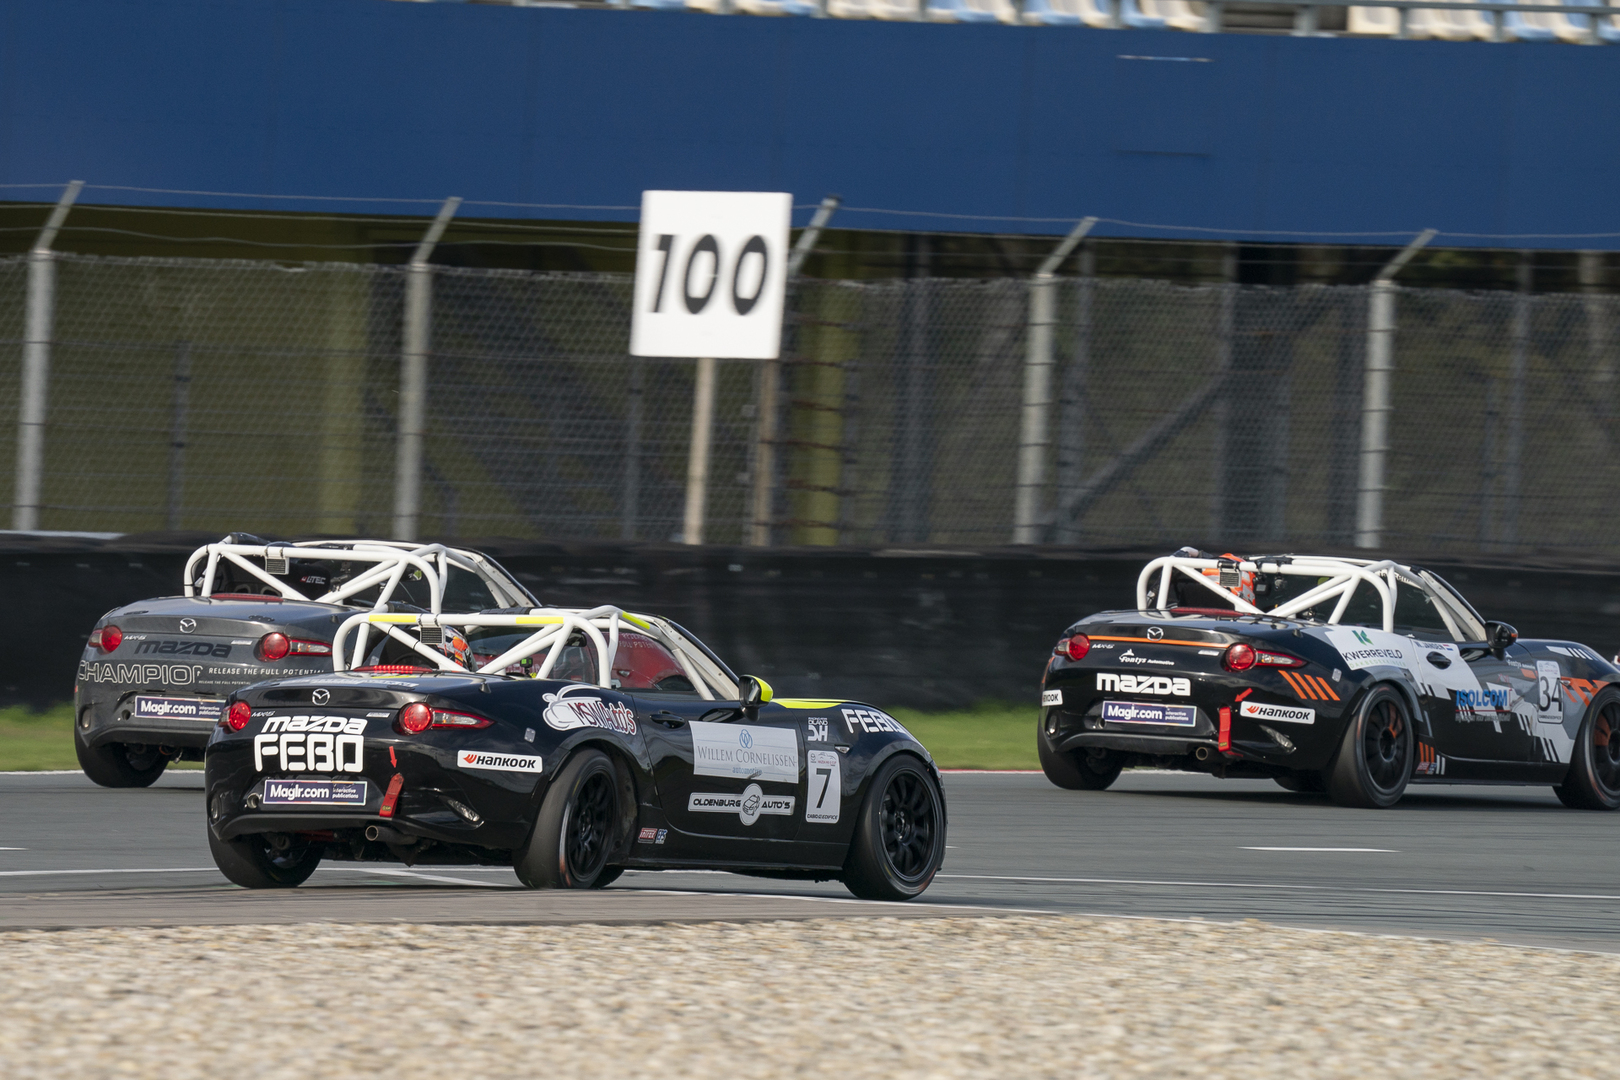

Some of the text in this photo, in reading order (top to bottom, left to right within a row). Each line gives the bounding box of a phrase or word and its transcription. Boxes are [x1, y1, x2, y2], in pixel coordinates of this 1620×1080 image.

[647, 234, 770, 316] 100
[1341, 649, 1403, 662] KWERREVELD
[208, 667, 241, 675] RELEASE
[1455, 689, 1508, 707] ISOLCOM
[1539, 676, 1562, 712] 34
[254, 734, 364, 773] FEBO
[816, 767, 832, 809] 7
[693, 798, 791, 810] OLDENBURG AUTO'S
